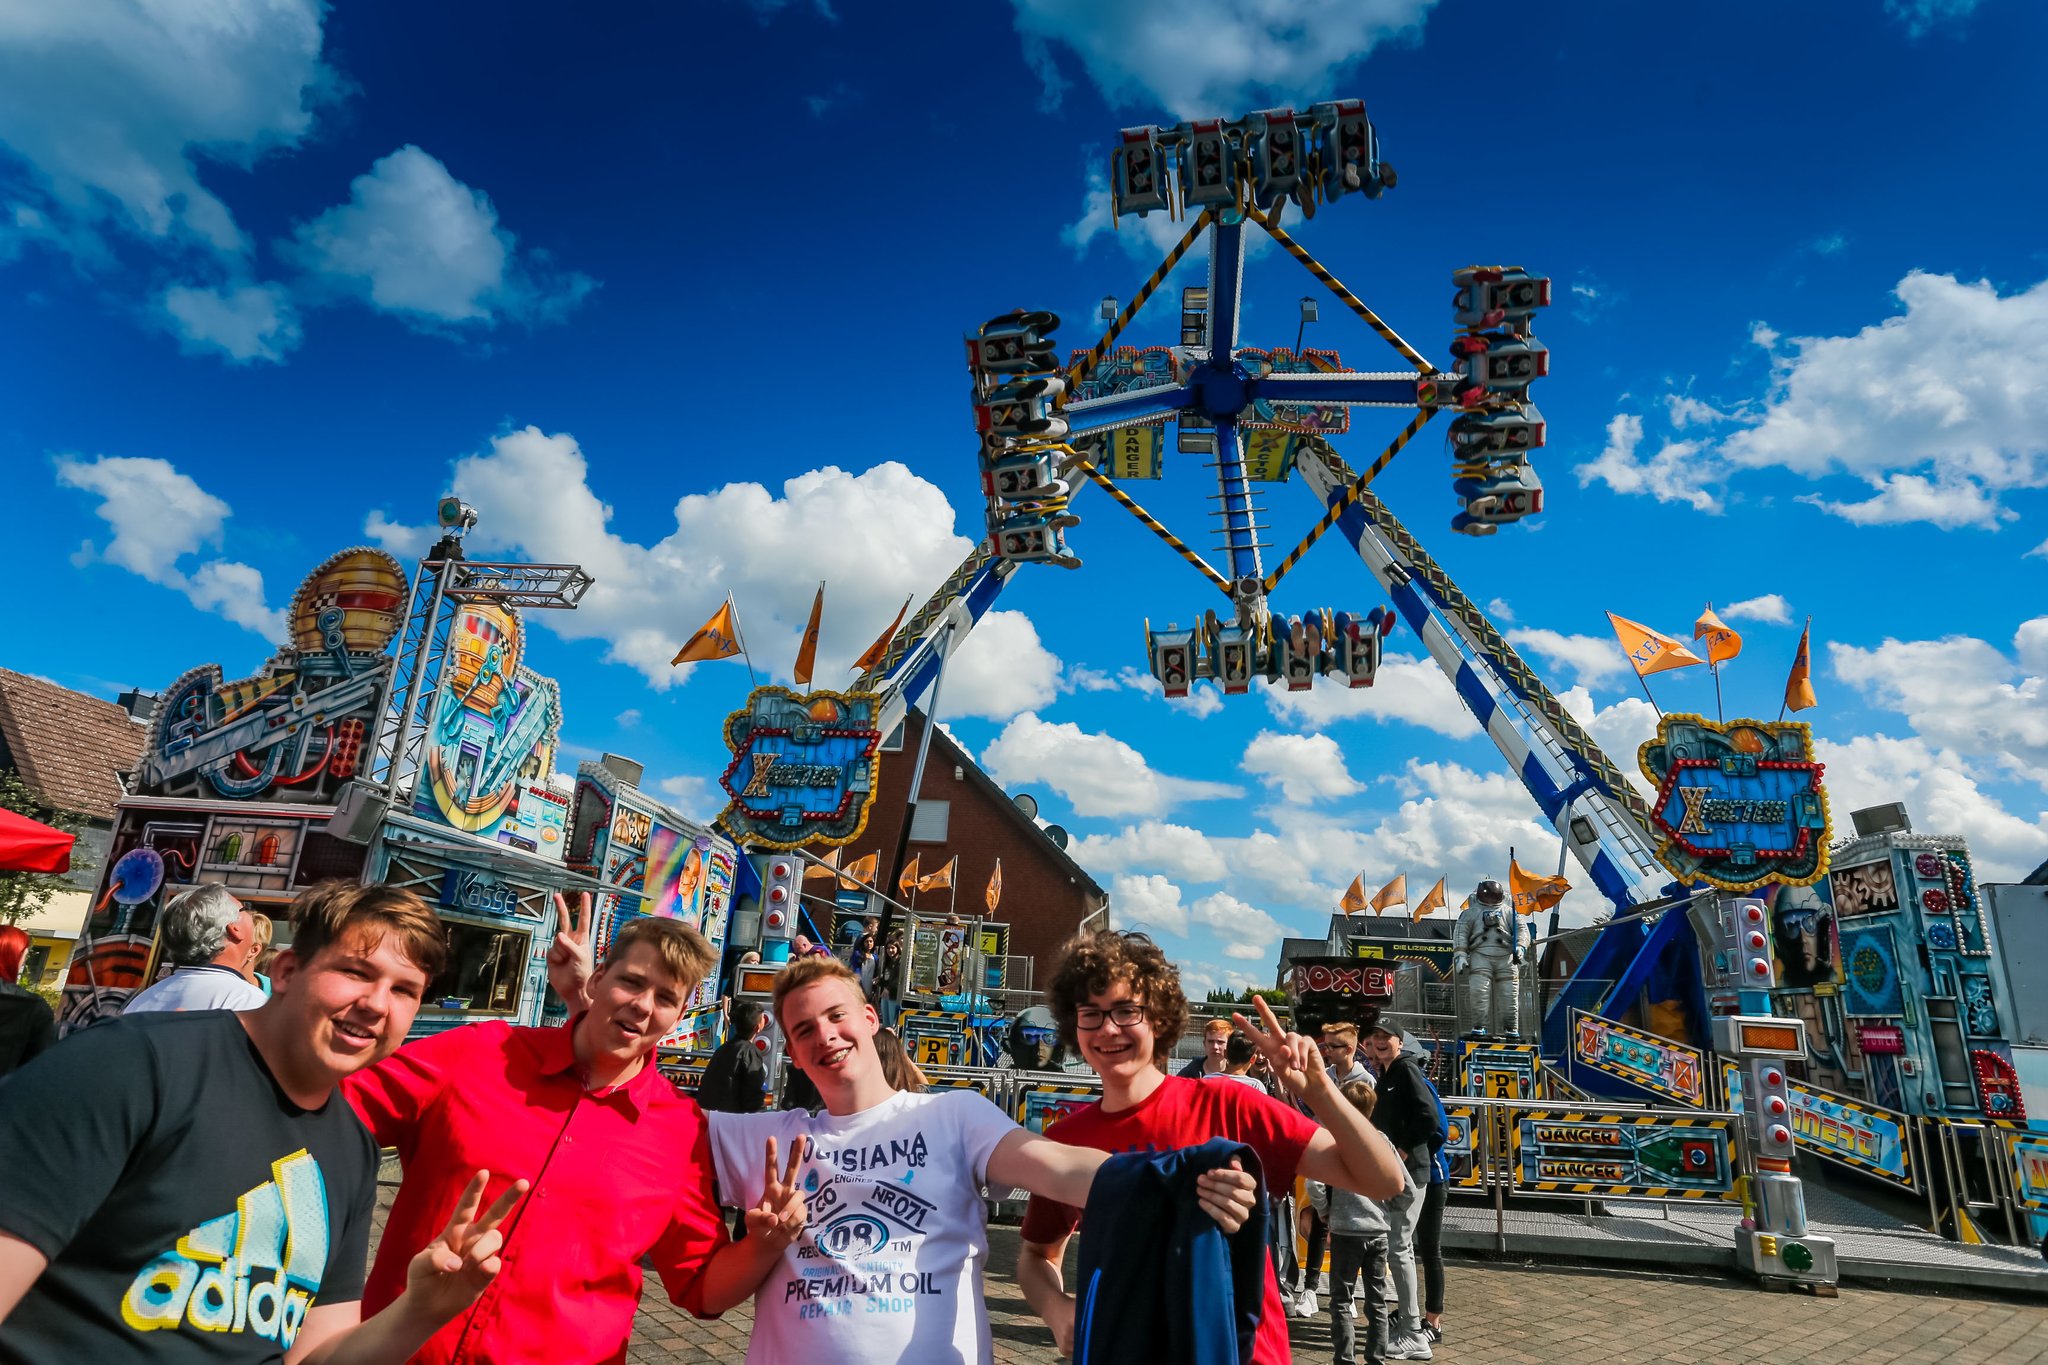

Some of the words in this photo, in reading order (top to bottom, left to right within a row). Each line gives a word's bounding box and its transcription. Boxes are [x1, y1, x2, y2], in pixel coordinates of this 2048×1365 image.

[1125, 428, 1140, 478] DANGER
[1863, 1030, 1898, 1046] POWER
[1540, 1128, 1614, 1143] DANGER
[1543, 1163, 1617, 1178] DANGER
[830, 1222, 872, 1252] 08
[891, 1241, 912, 1252] TM
[785, 1274, 891, 1304] PREMIUM
[900, 1272, 941, 1295] OIL
[121, 1250, 316, 1350] adida
[800, 1300, 852, 1320] REPAIR
[866, 1297, 914, 1313] SHOP
